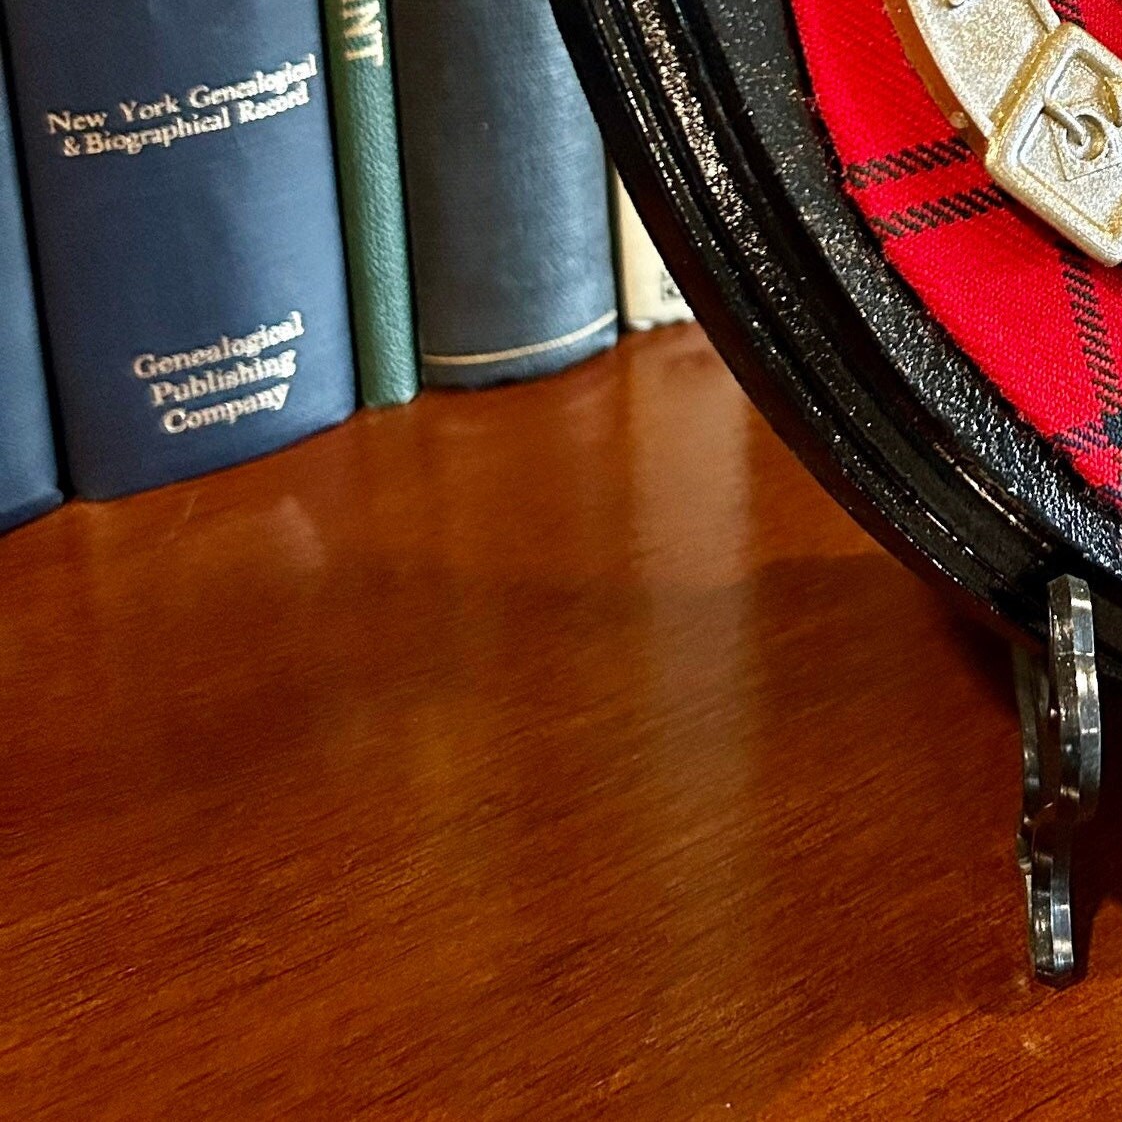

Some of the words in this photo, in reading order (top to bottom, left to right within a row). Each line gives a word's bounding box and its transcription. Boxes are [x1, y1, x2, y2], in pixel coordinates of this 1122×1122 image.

[46, 109, 108, 134] New
[118, 94, 181, 122] York
[189, 53, 318, 108] Genealogical
[62, 135, 81, 157] &
[84, 105, 231, 155] Biographical
[237, 80, 310, 124] Record
[132, 311, 305, 378] Genealogical
[150, 349, 297, 407] Publishing
[161, 383, 291, 434] Company
